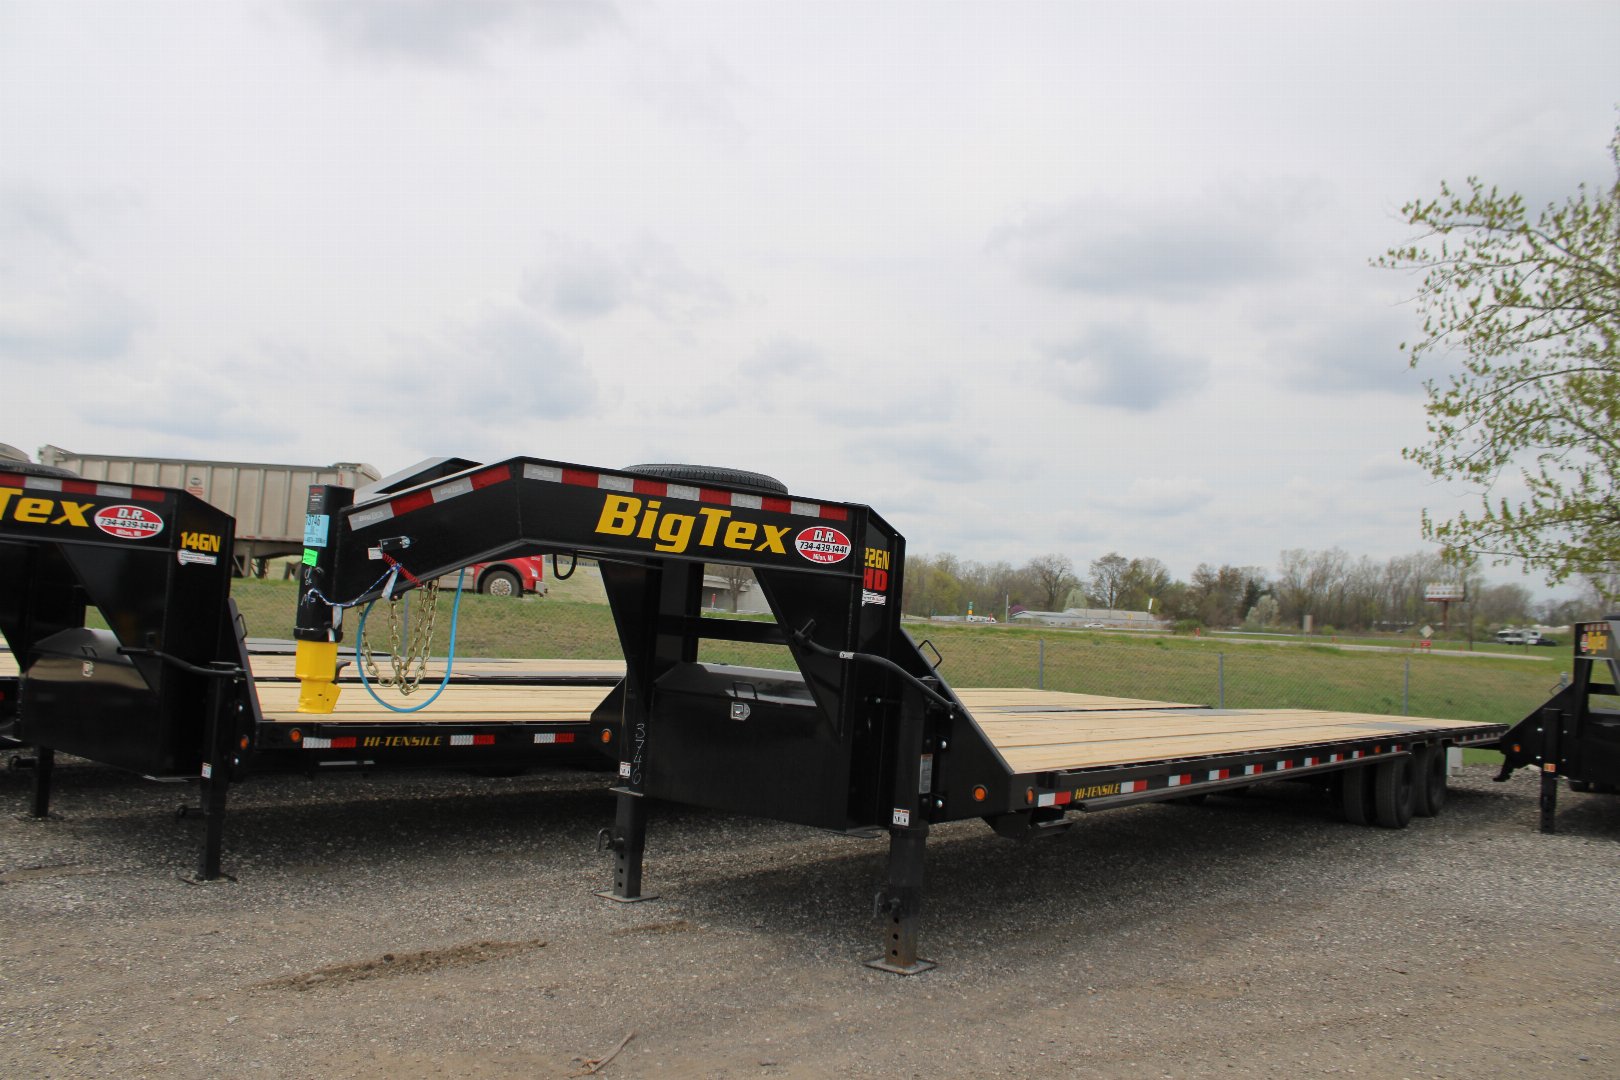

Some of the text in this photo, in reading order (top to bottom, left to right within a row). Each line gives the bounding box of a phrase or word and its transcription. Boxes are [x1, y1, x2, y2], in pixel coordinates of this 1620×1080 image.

[117, 508, 145, 520] D.R.
[101, 518, 159, 530] 734-439-1441
[595, 494, 792, 554] BigTex
[181, 531, 221, 552] 14GN
[813, 530, 836, 543] D.R.
[800, 542, 848, 554] 734-439-1441
[363, 736, 442, 747] HI-TENSILE
[632, 723, 646, 785] 3746
[1074, 783, 1120, 800] HI-TENSILE
